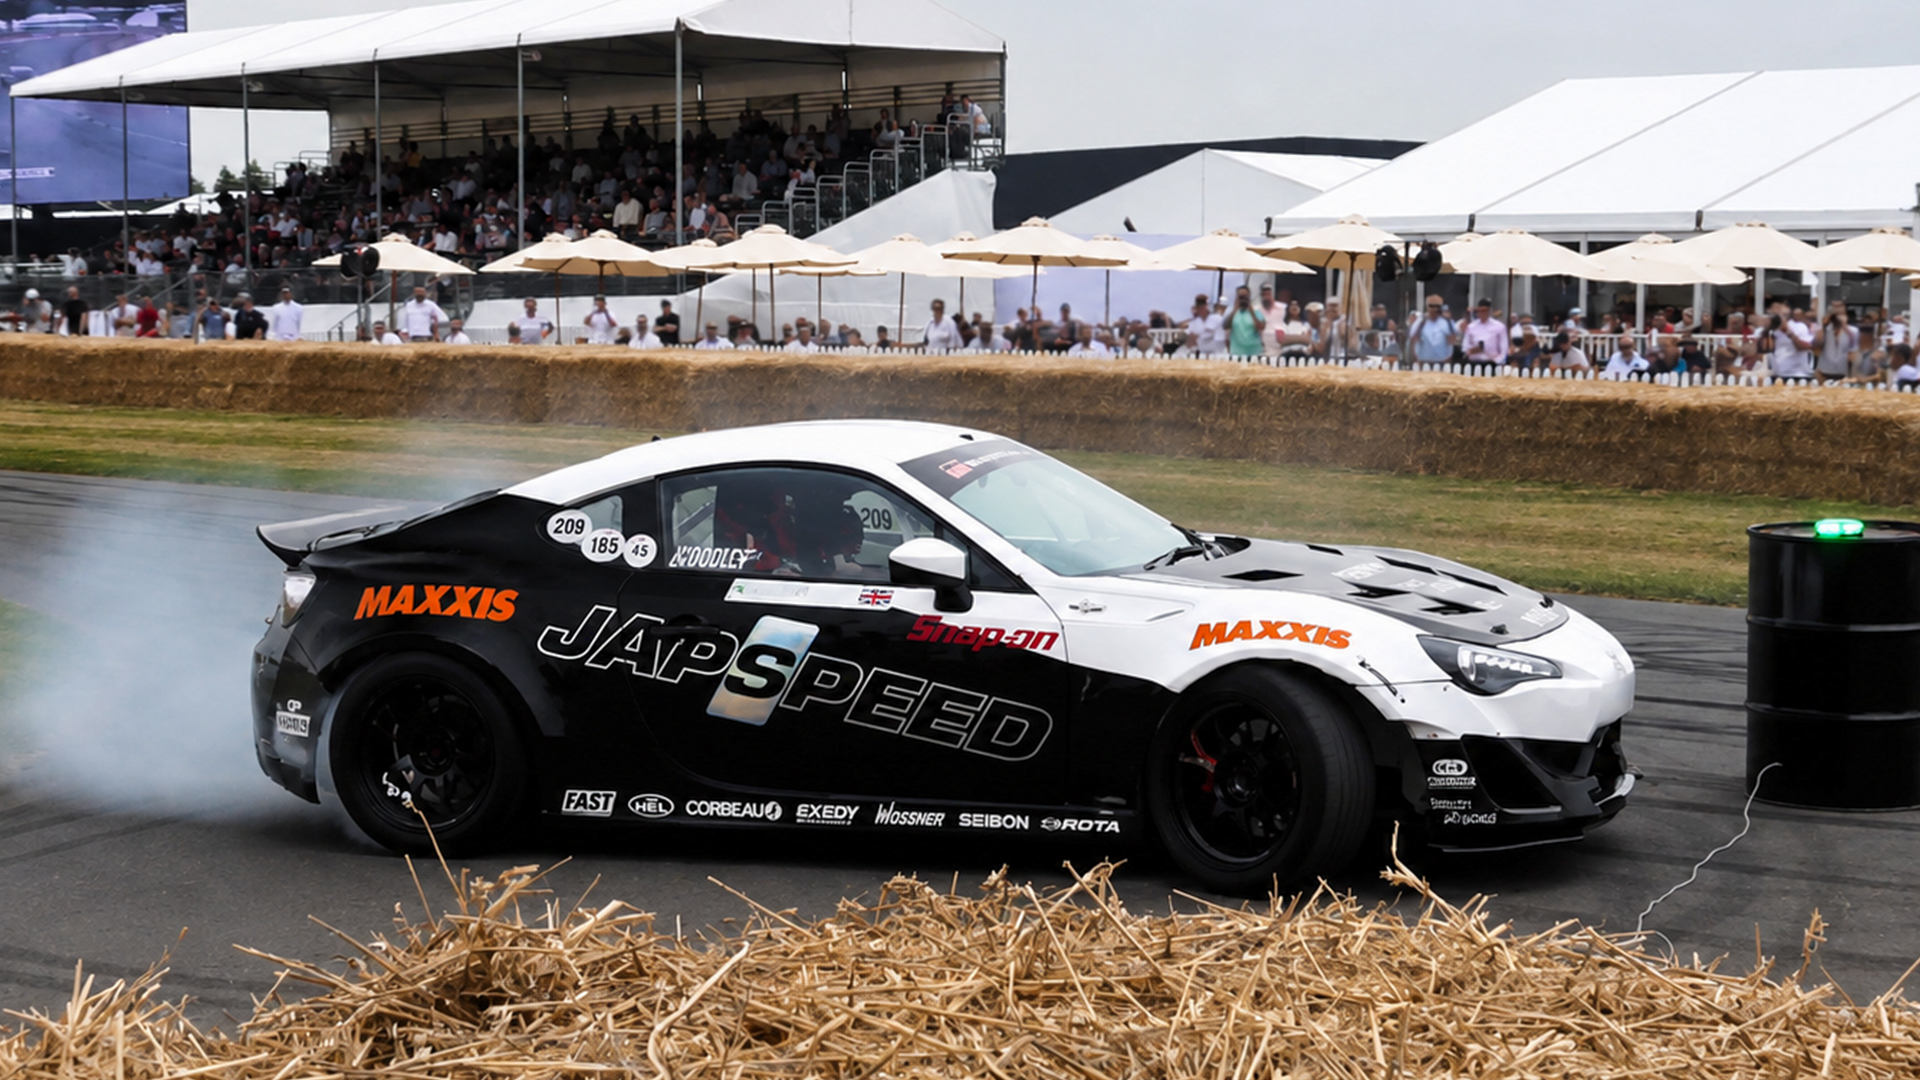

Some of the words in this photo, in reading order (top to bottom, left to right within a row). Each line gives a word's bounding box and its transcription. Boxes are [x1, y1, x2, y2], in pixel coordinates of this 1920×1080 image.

[553, 517, 585, 535] 209
[860, 507, 893, 530] 209
[592, 536, 619, 554] 185
[631, 544, 649, 557] 45
[353, 584, 519, 622] MAXXIS
[906, 614, 1060, 652] Snap-on
[1189, 620, 1352, 651] MAXXIS
[537, 605, 1053, 761] JAPSPEED
[564, 791, 614, 811] FAST
[685, 800, 764, 819] CORBEAU
[796, 803, 860, 820] EXEDY
[958, 812, 1030, 830] SEIBON
[1060, 818, 1121, 834] ROTA
